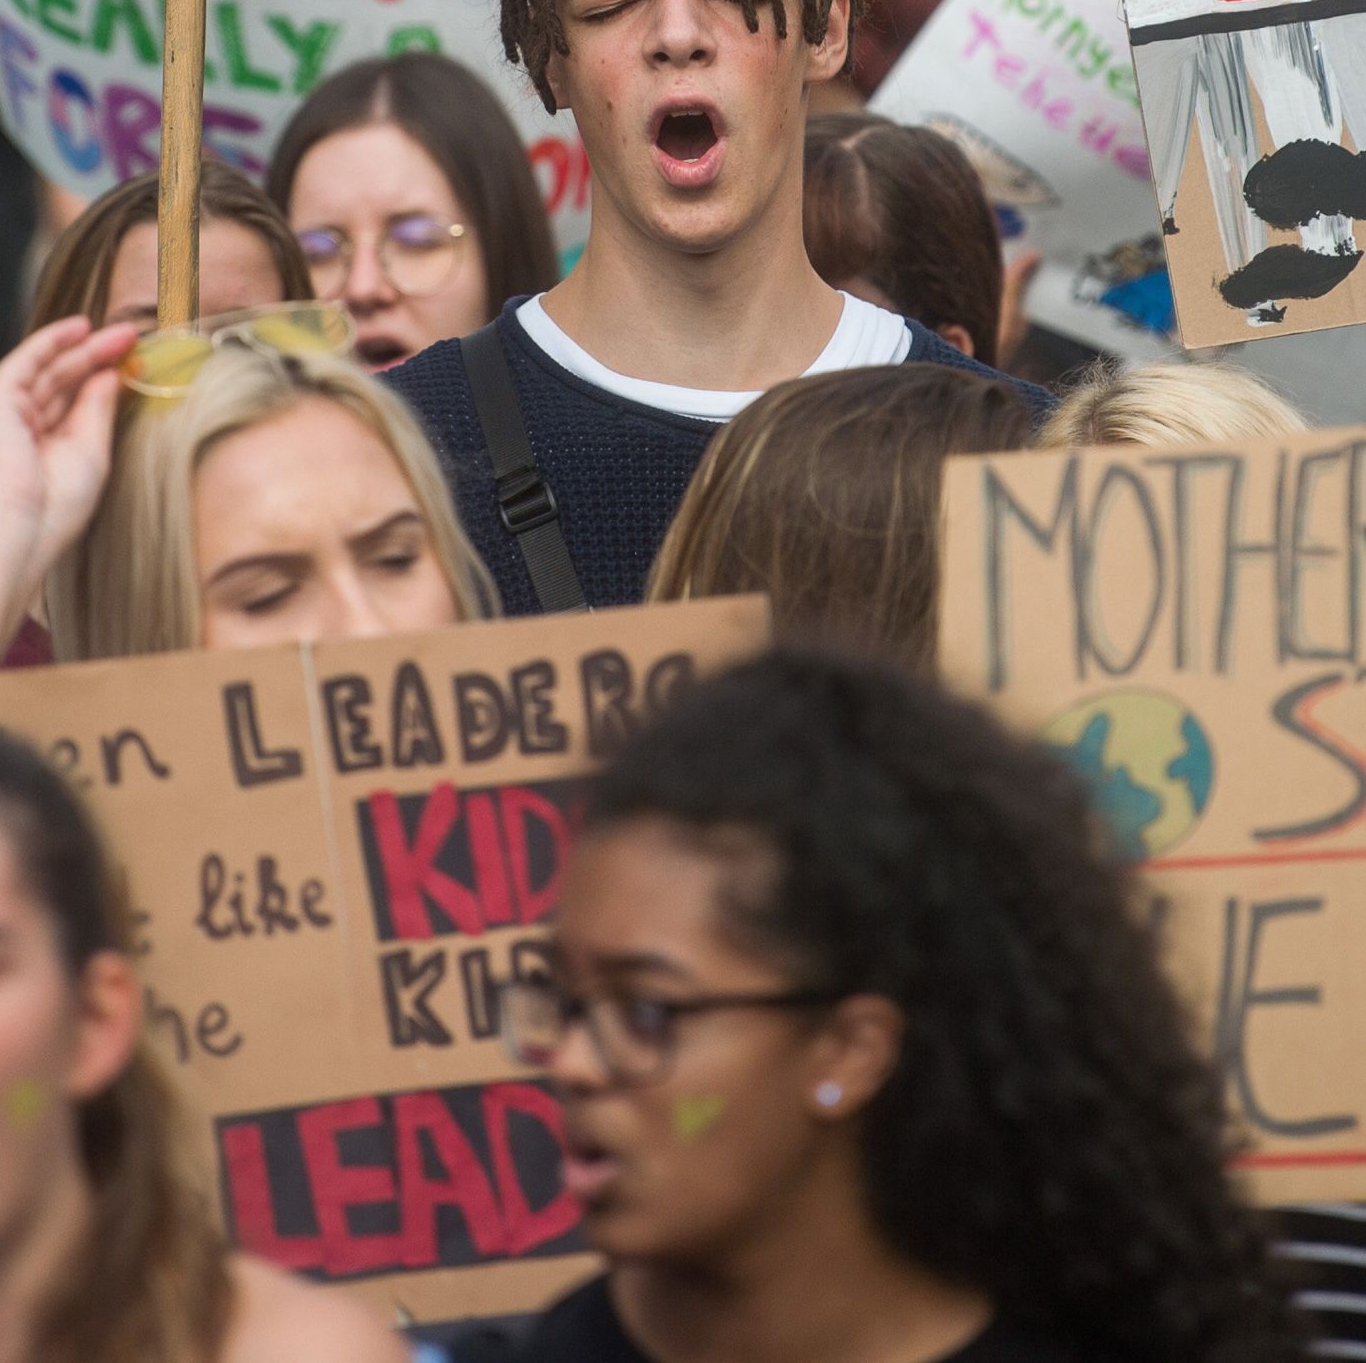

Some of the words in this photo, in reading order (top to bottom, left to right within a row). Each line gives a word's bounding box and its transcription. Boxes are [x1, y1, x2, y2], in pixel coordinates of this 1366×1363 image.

[194, 851, 333, 940] like
[367, 778, 591, 943] KID
[142, 983, 246, 1065] he
